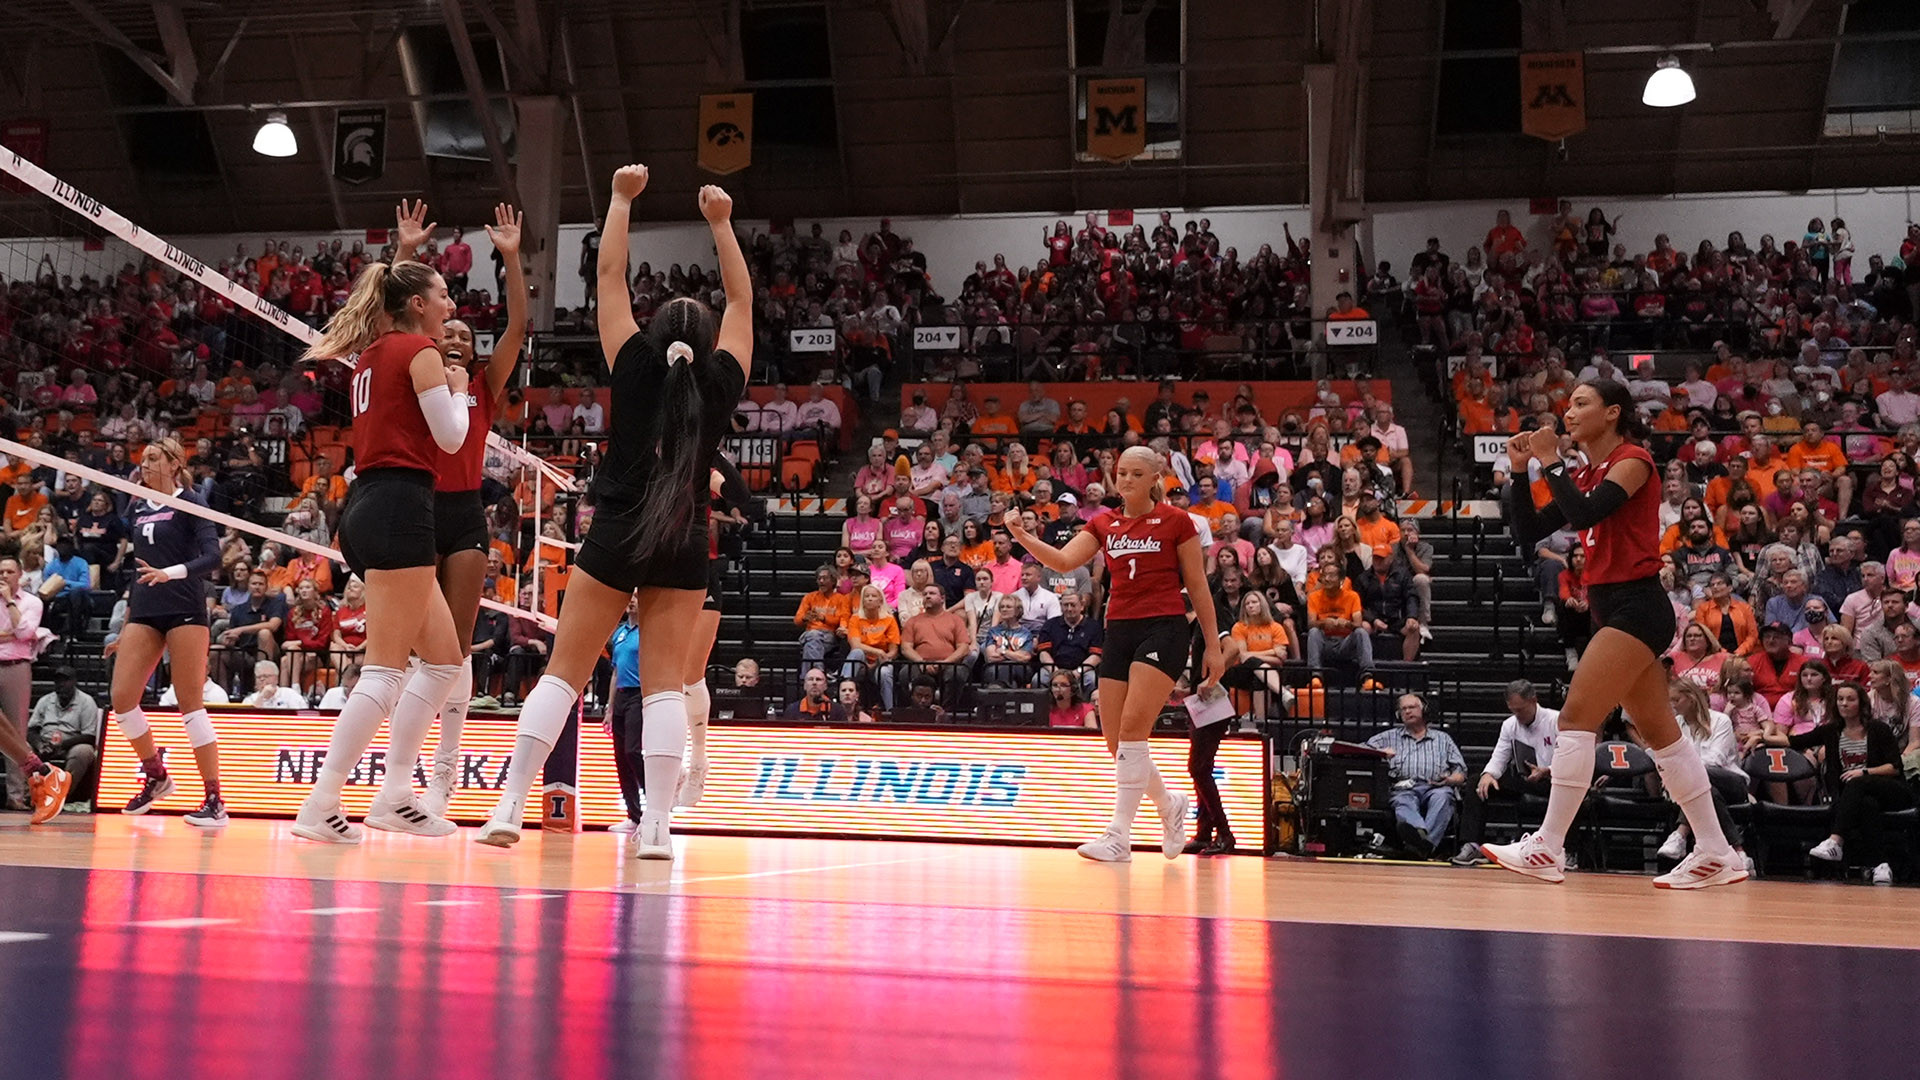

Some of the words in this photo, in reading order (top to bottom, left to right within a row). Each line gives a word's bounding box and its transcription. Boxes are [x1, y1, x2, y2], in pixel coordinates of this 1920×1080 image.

[52, 179, 104, 218] ILLINOIS
[164, 244, 206, 277] ILLINOIS
[255, 297, 289, 325] ILLINOIS
[809, 334, 832, 345] 203
[917, 332, 941, 342] 204
[1346, 326, 1373, 337] 204
[352, 367, 372, 418] 10
[1479, 442, 1507, 454] 105
[142, 523, 155, 544] 9
[1106, 534, 1160, 550] Nebraska
[1128, 558, 1136, 580] 1
[751, 757, 1027, 807] ILLINOIS
